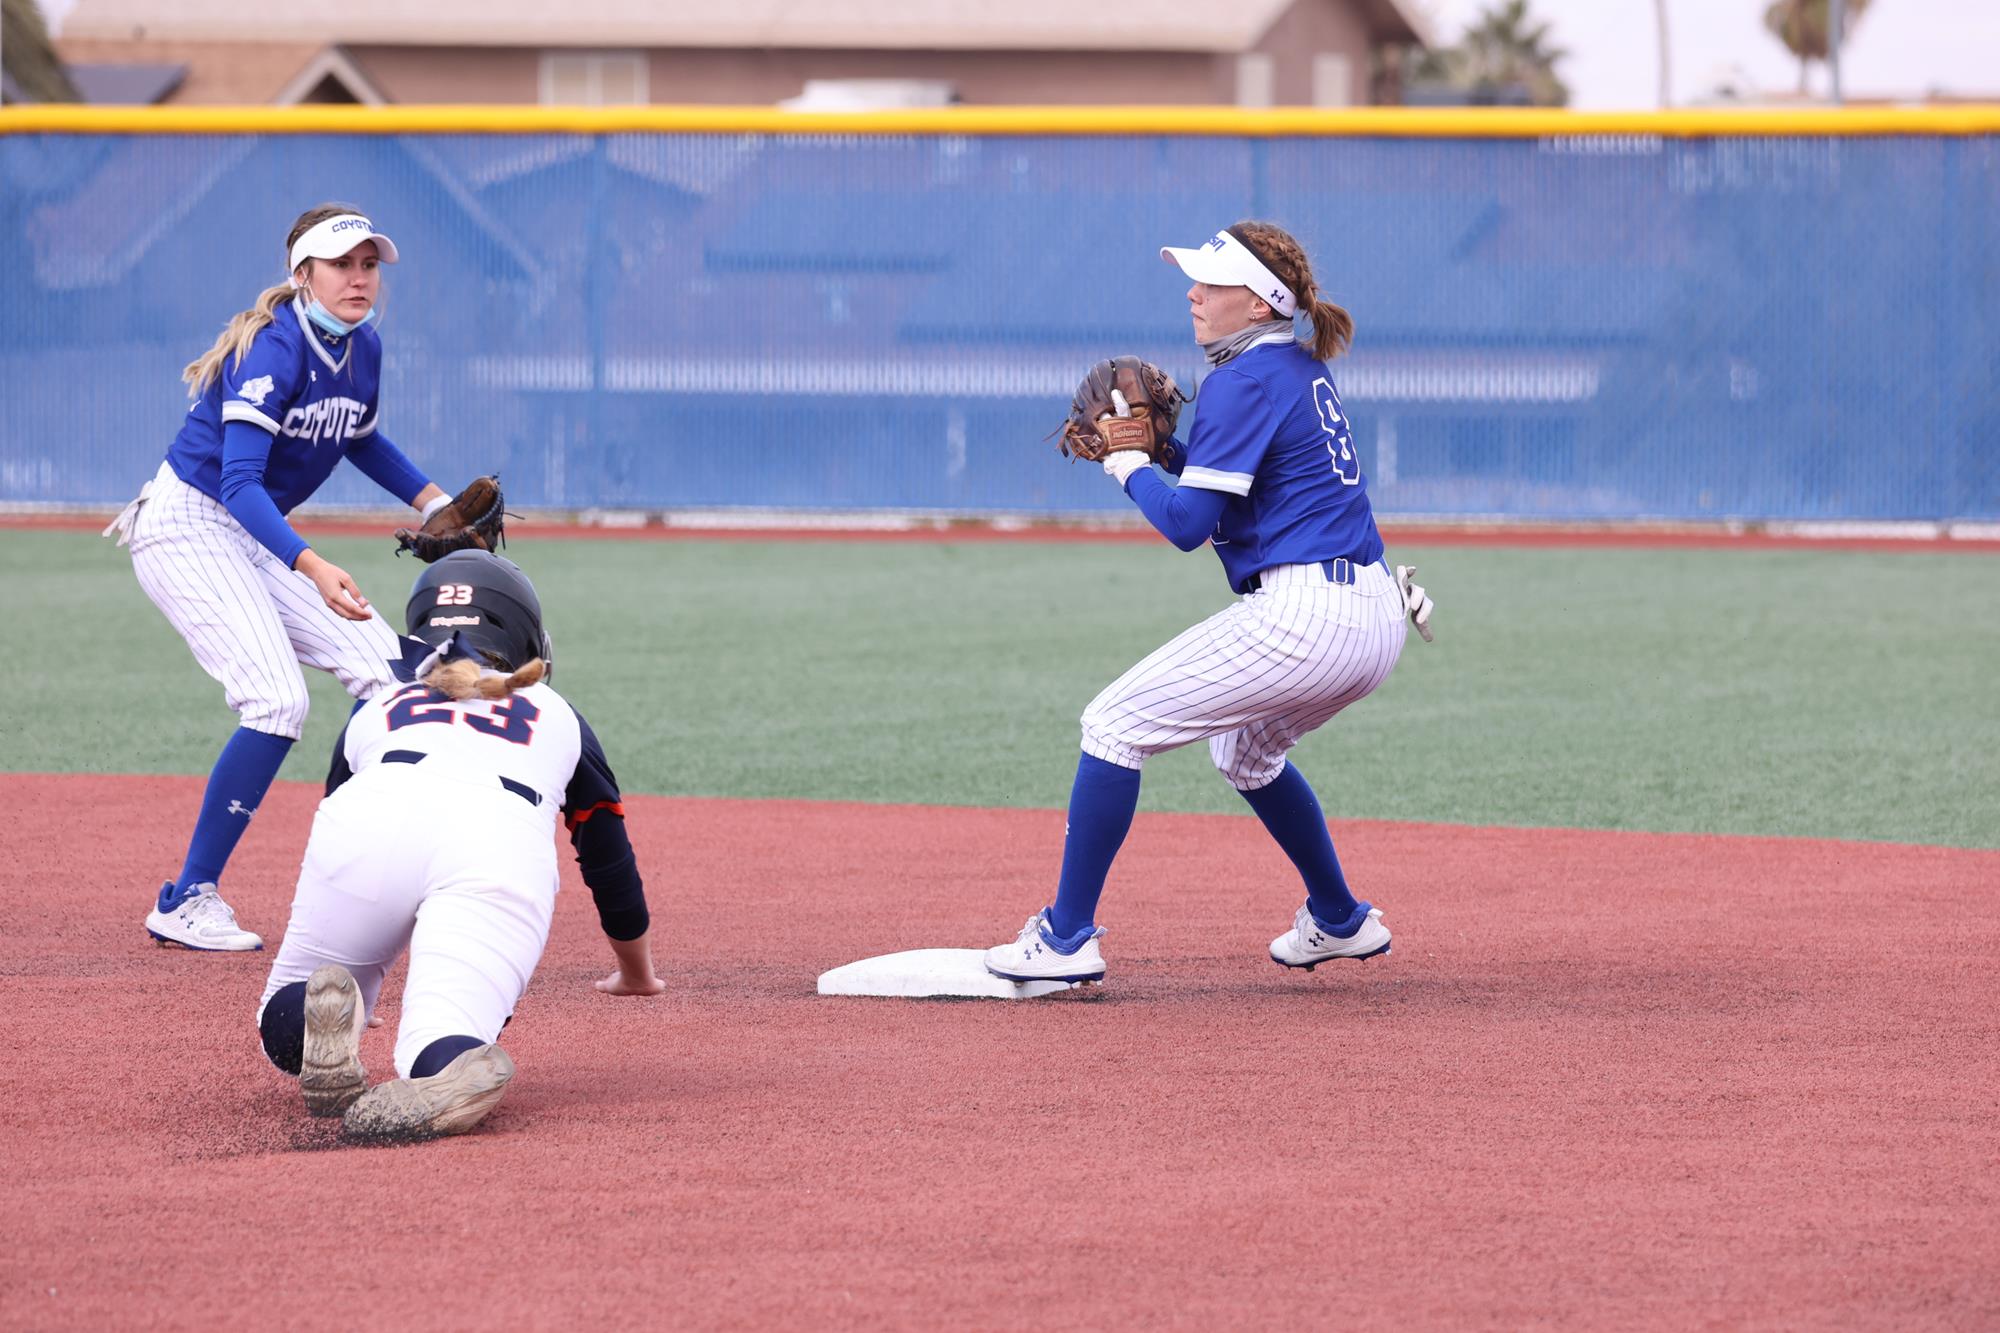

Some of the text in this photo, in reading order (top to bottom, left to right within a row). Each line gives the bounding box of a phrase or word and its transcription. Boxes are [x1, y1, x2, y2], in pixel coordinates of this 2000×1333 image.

[1312, 376, 1361, 486] 8
[436, 584, 474, 606] 23
[382, 683, 541, 747] 23
